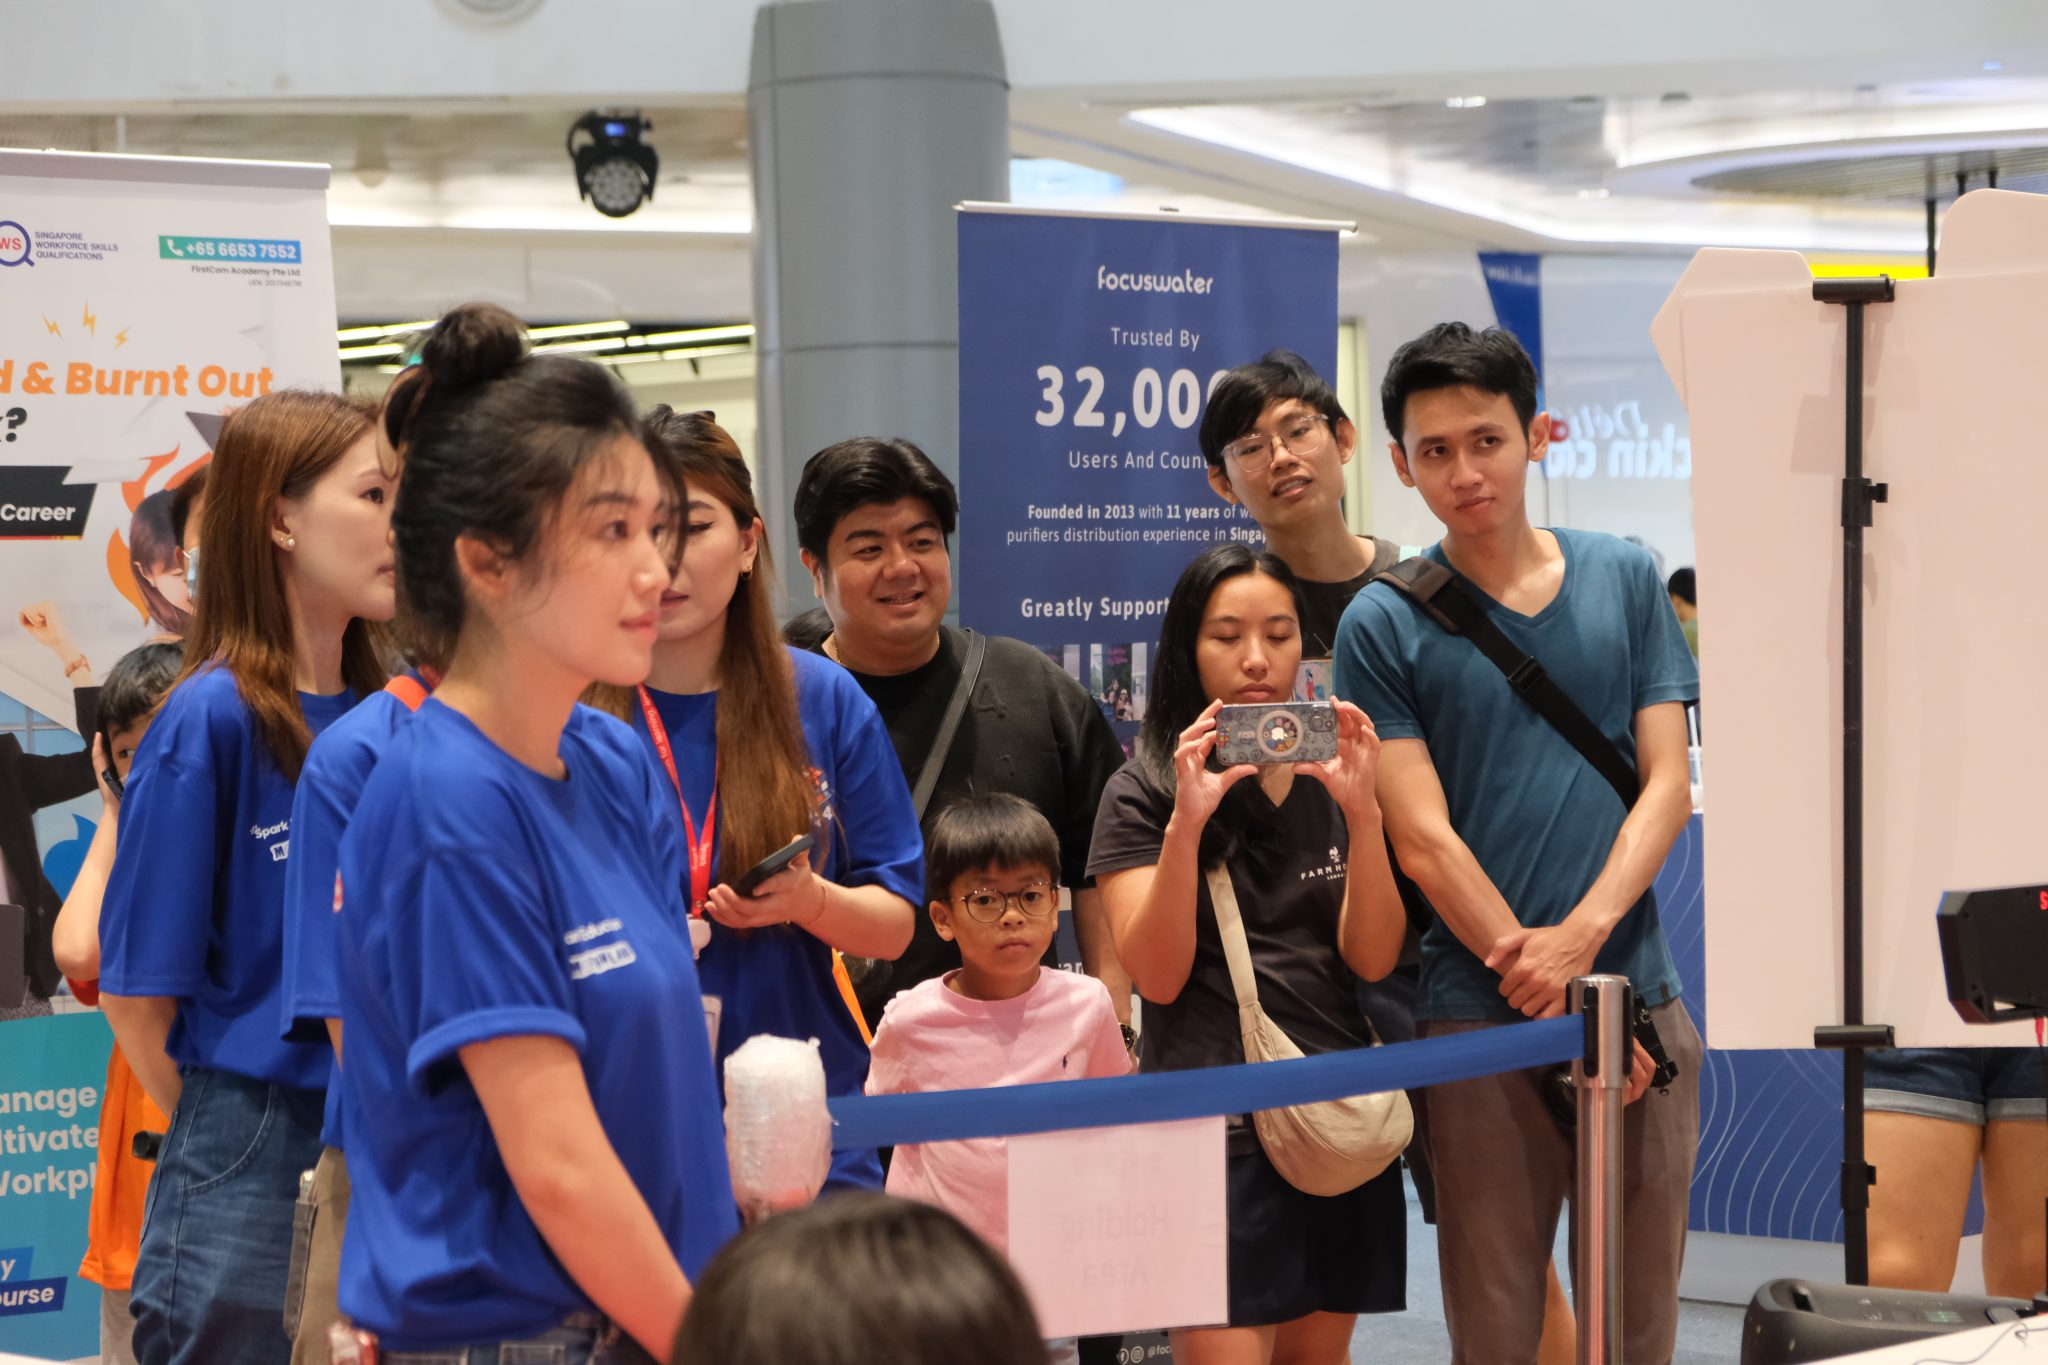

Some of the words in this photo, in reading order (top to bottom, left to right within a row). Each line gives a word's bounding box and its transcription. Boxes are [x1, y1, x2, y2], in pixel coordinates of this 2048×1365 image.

[35, 231, 83, 240] SINGAPORE
[36, 241, 88, 250] WORKFORCE
[91, 243, 119, 252] SKILLS
[36, 251, 104, 260] QUALIFICATIONS
[186, 241, 215, 256] +65
[218, 242, 256, 258] 6653
[258, 244, 297, 259] 7552
[231, 267, 270, 277] Academy
[273, 268, 286, 276] Pte
[1097, 265, 1214, 295] focuswater
[1111, 327, 1173, 347] Trusted
[1180, 330, 1200, 352] By
[22, 362, 55, 395] &
[65, 362, 189, 397] Burnt
[198, 365, 273, 398] Out
[1069, 451, 1118, 469] Users
[1125, 451, 1154, 469] And
[0, 504, 75, 522] Career
[1028, 504, 1083, 519] Founded
[1087, 505, 1100, 519] in
[1104, 504, 1135, 519] 2013
[1139, 505, 1163, 519] with
[1166, 505, 1181, 519] 11
[1185, 507, 1220, 522] years
[1223, 504, 1236, 519] of
[1007, 527, 1060, 546] purifiers
[1064, 526, 1139, 542] distribution
[1143, 528, 1210, 544] experience
[1215, 527, 1226, 541] in
[1021, 597, 1093, 621] Greatly
[1100, 597, 1170, 621] Support
[0, 1287, 55, 1307] urse
